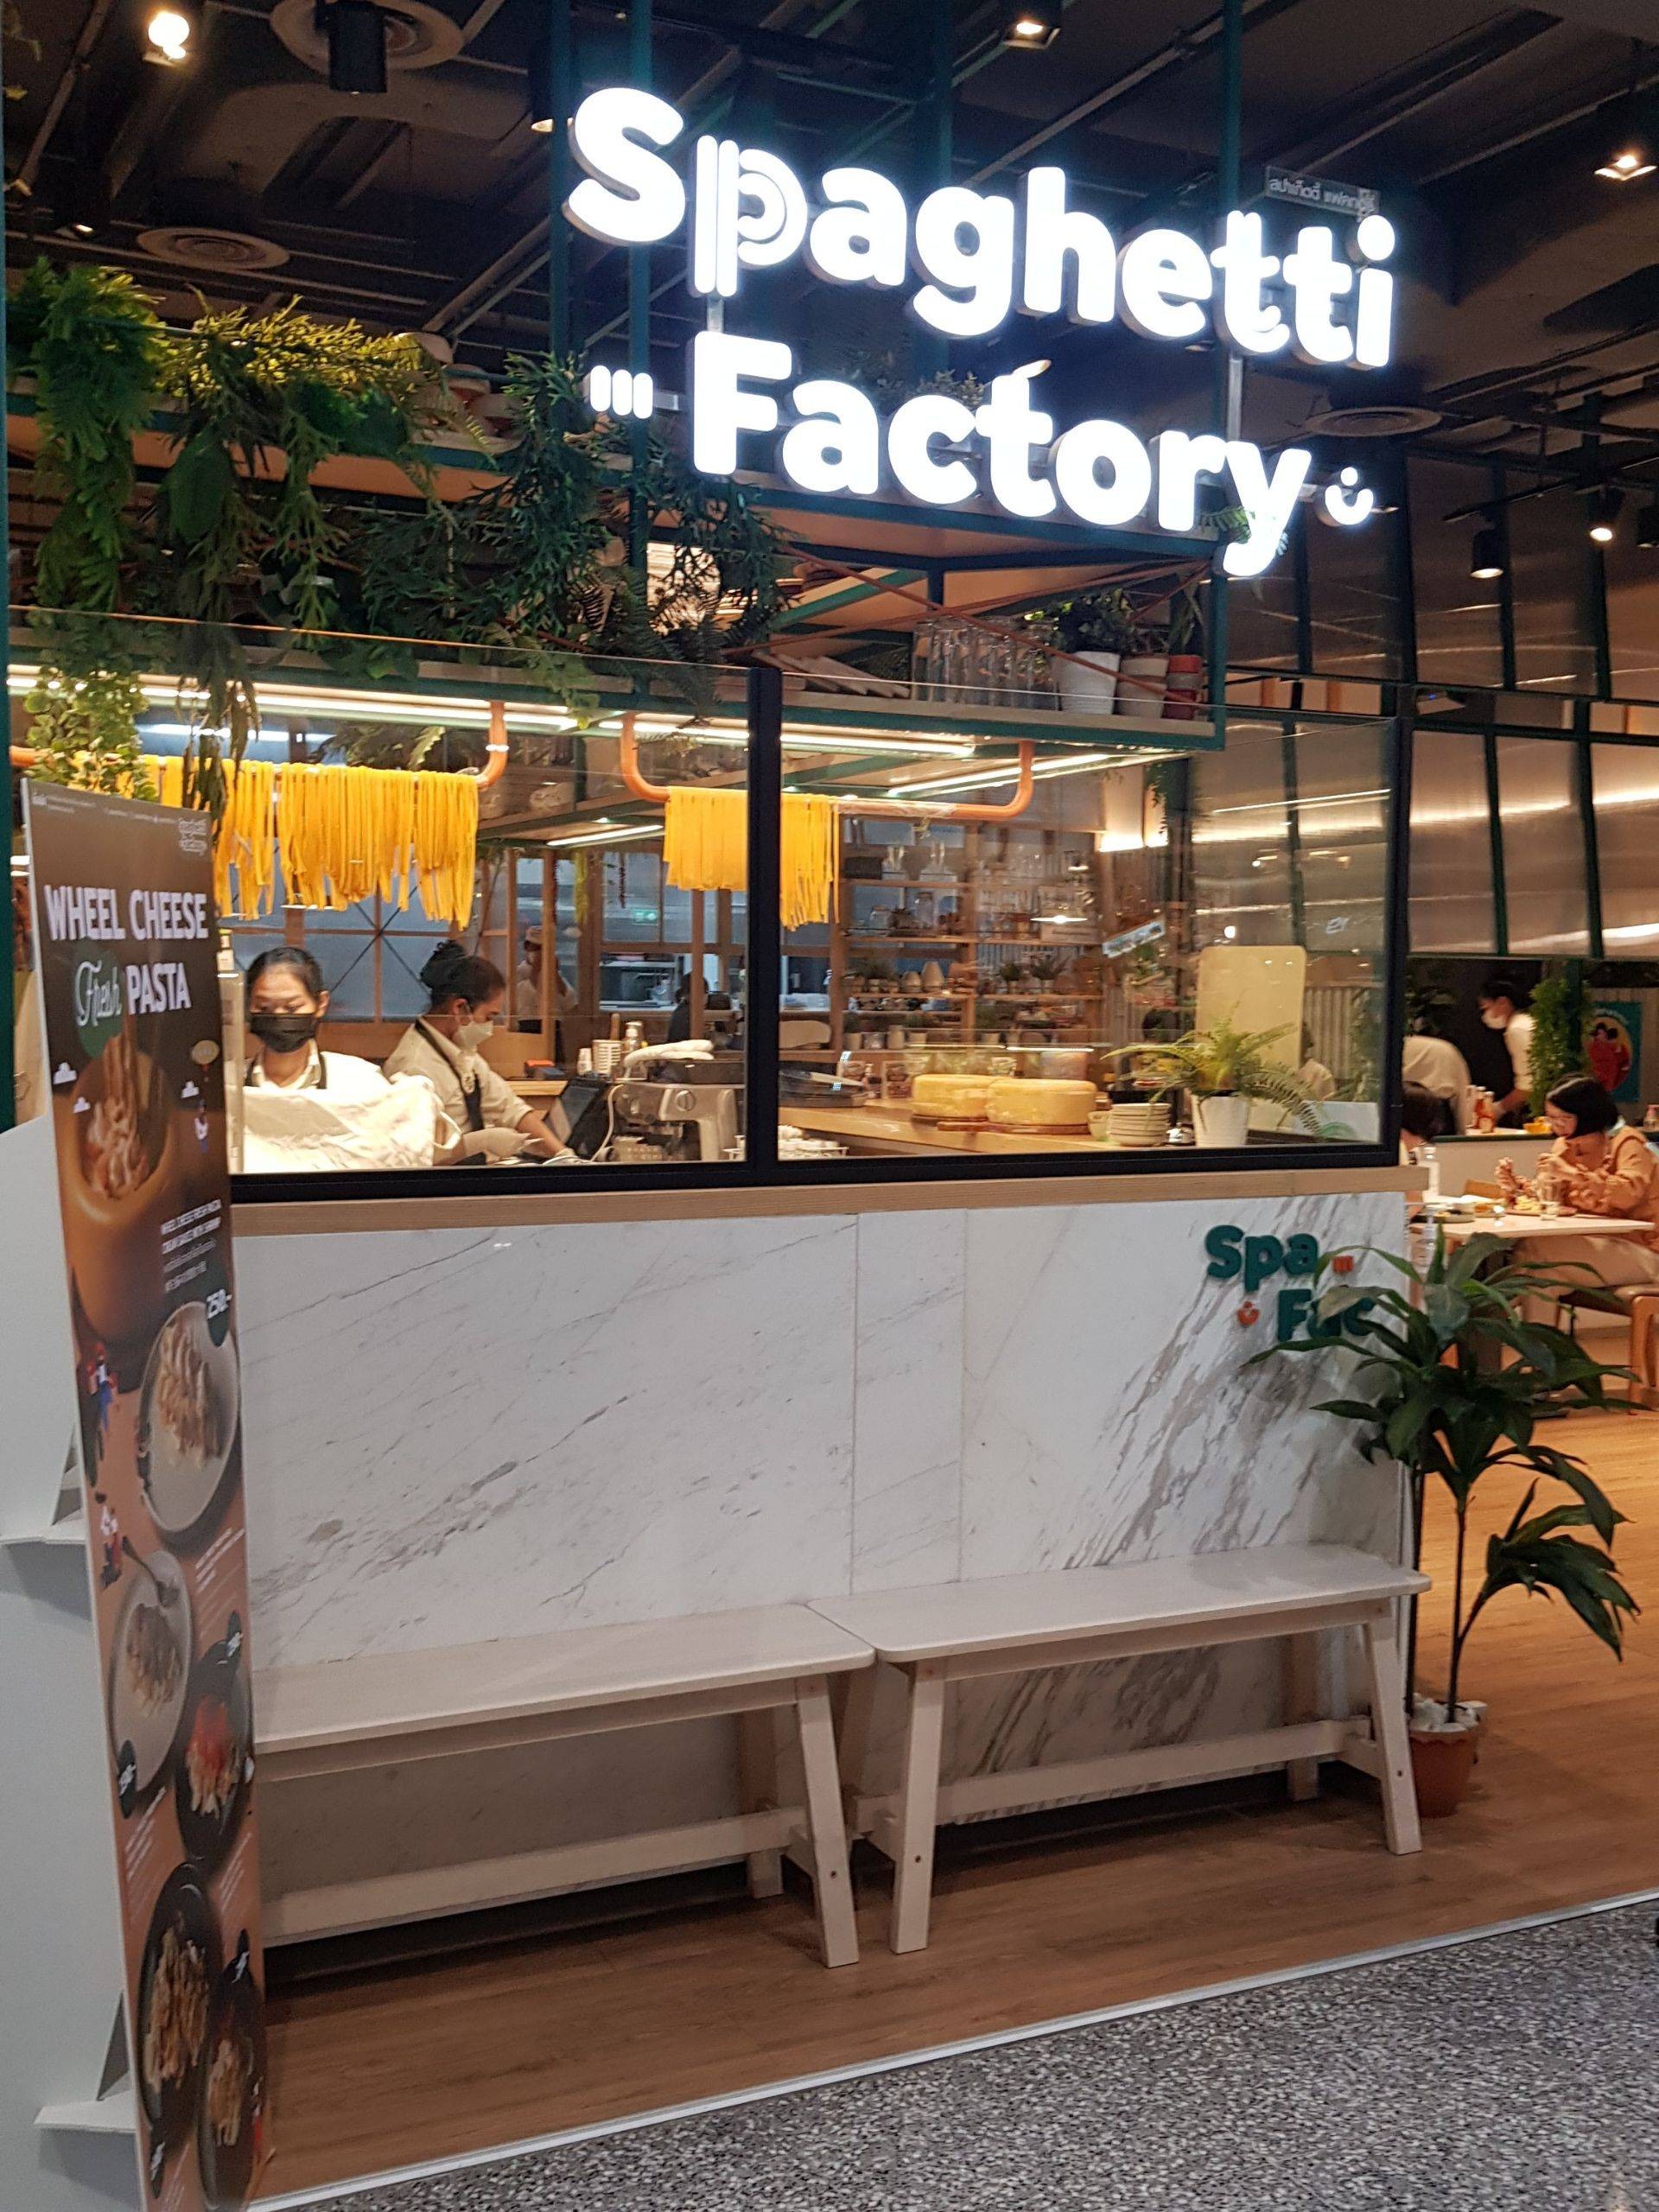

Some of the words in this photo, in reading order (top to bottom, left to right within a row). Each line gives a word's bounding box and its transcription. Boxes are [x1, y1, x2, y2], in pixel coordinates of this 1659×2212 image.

[564, 86, 1396, 369] Spaghetti
[691, 328, 1313, 577] Factory
[43, 884, 126, 941] WHEEL
[130, 888, 209, 941] CHEESE
[74, 959, 123, 1027] Fresh
[124, 962, 192, 1016] PASTA
[1205, 1224, 1319, 1293] Spa
